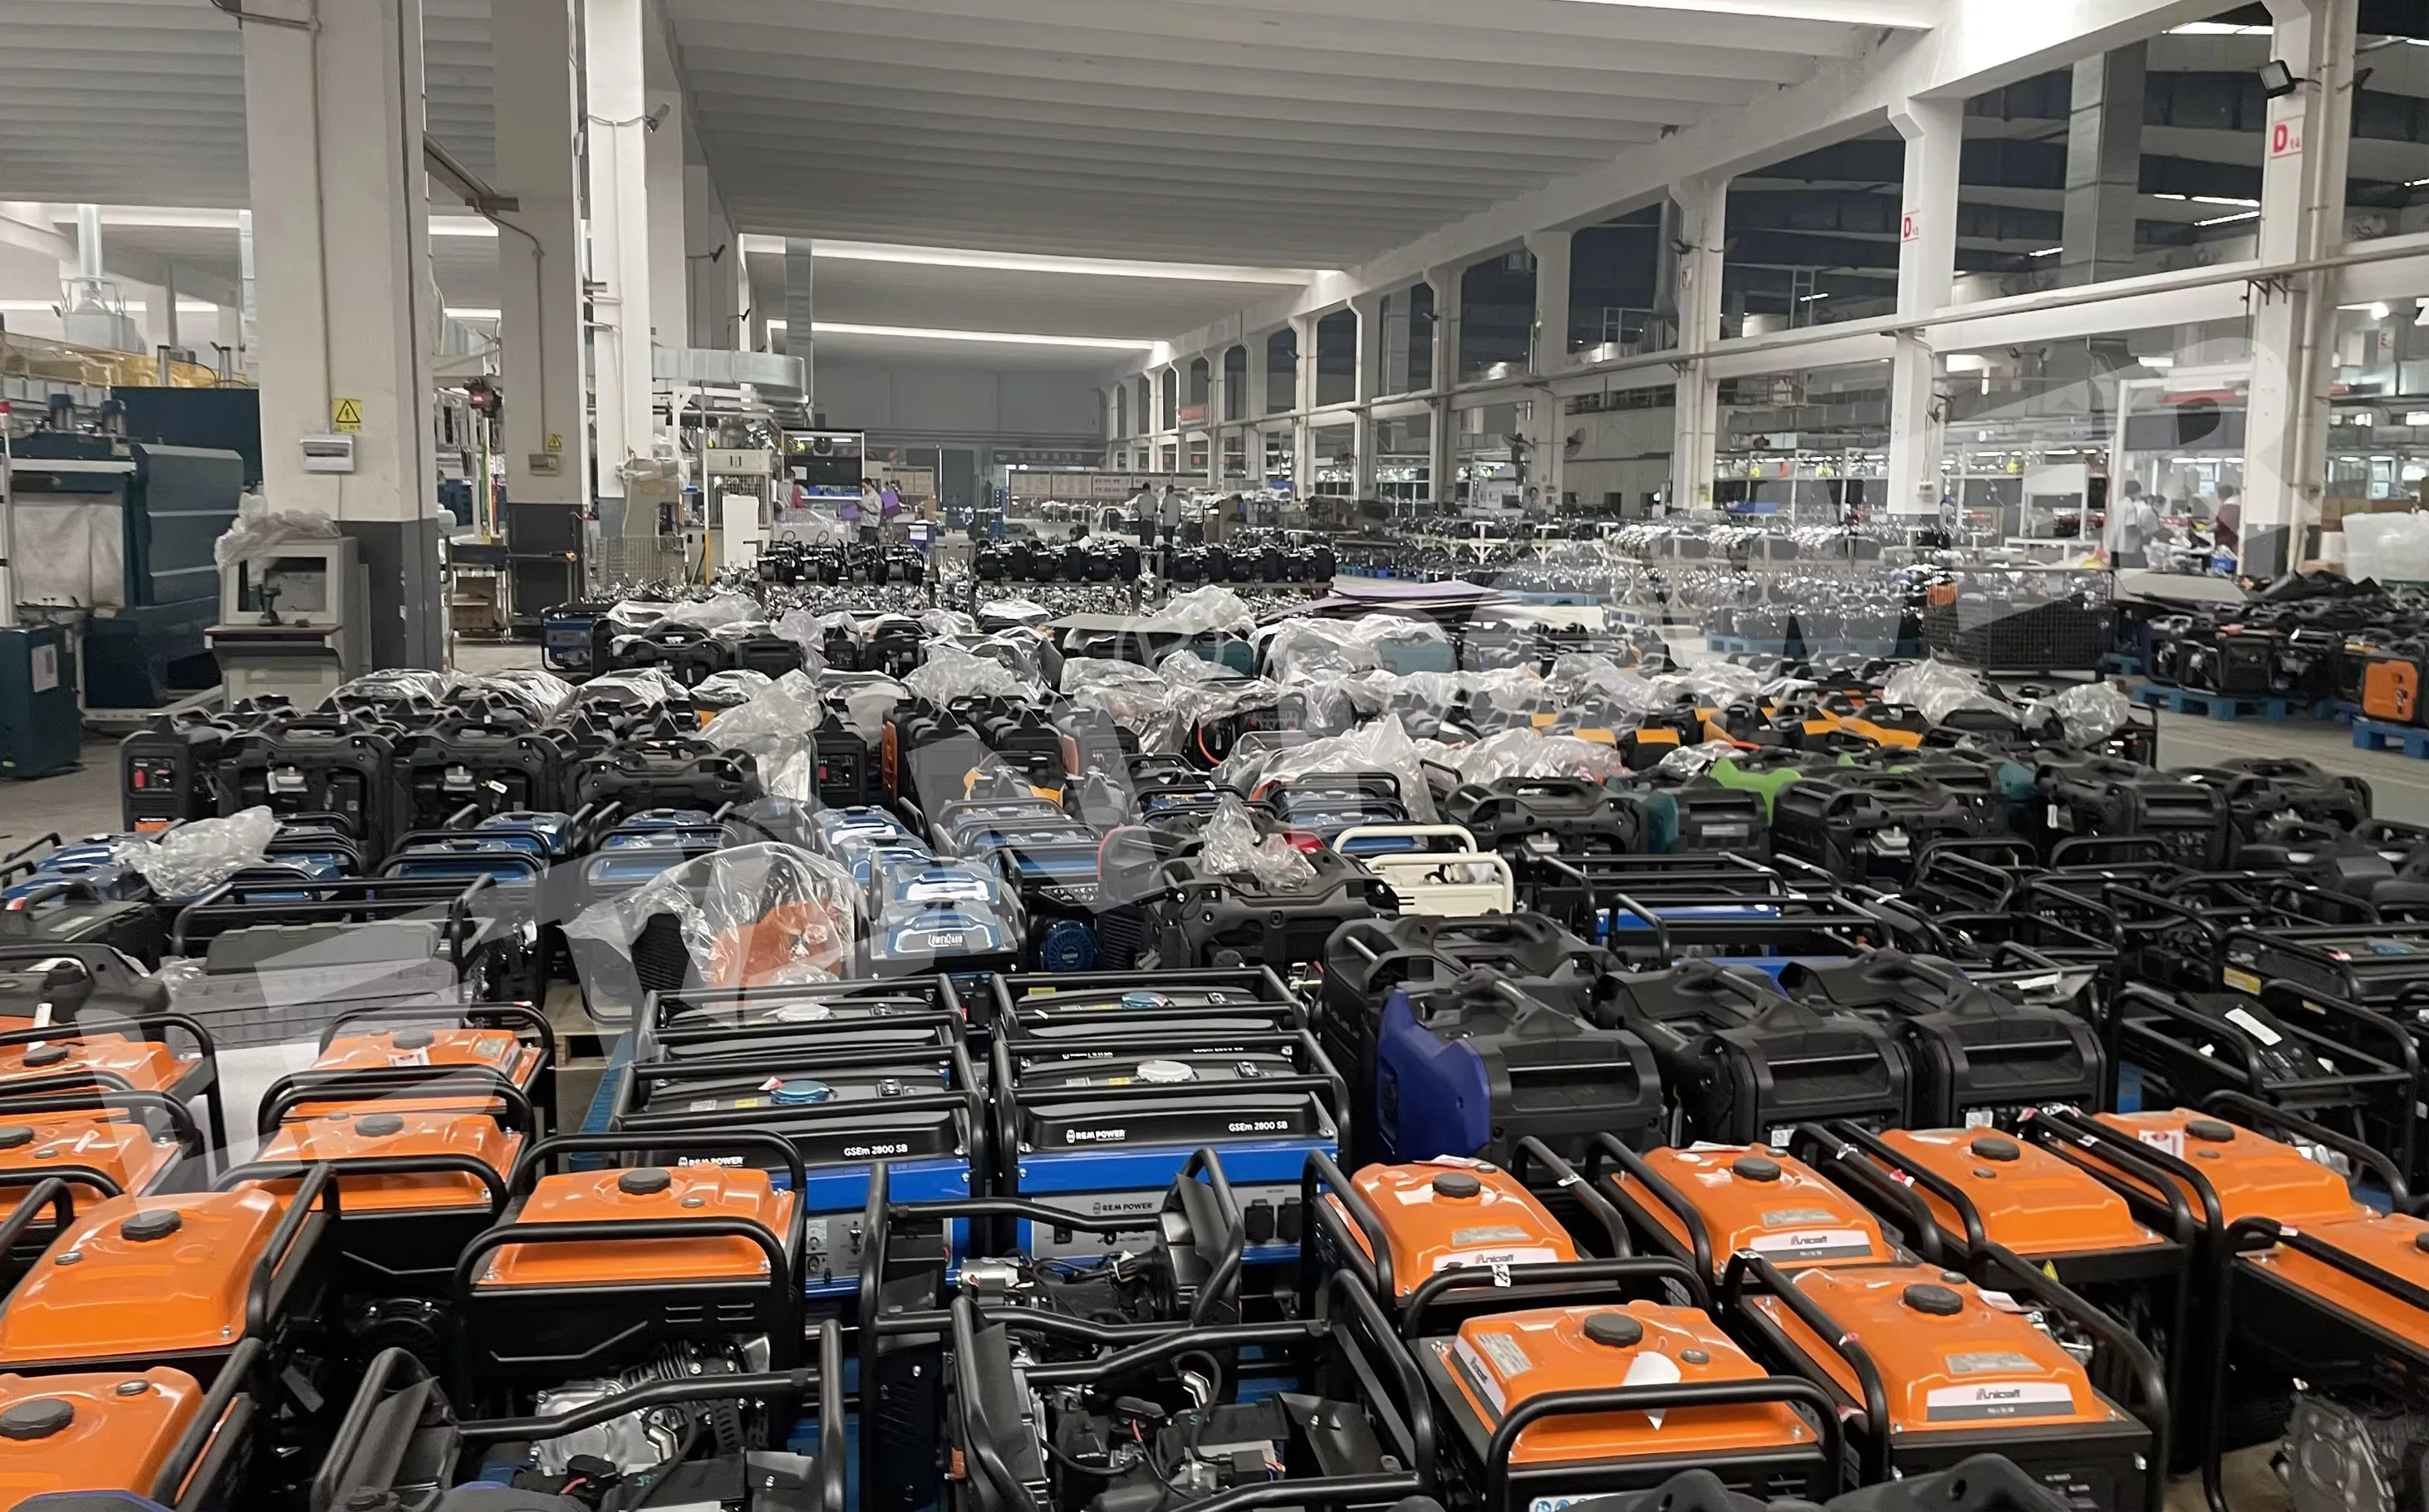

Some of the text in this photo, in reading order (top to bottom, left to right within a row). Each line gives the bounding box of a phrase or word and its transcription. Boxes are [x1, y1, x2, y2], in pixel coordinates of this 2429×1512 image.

[1228, 1121, 1288, 1132] GSEm 2800 SB
[1076, 1129, 1126, 1140] REM POWER
[844, 1145, 908, 1156] GSEm 2800 SB
[712, 1156, 743, 1166] POWER
